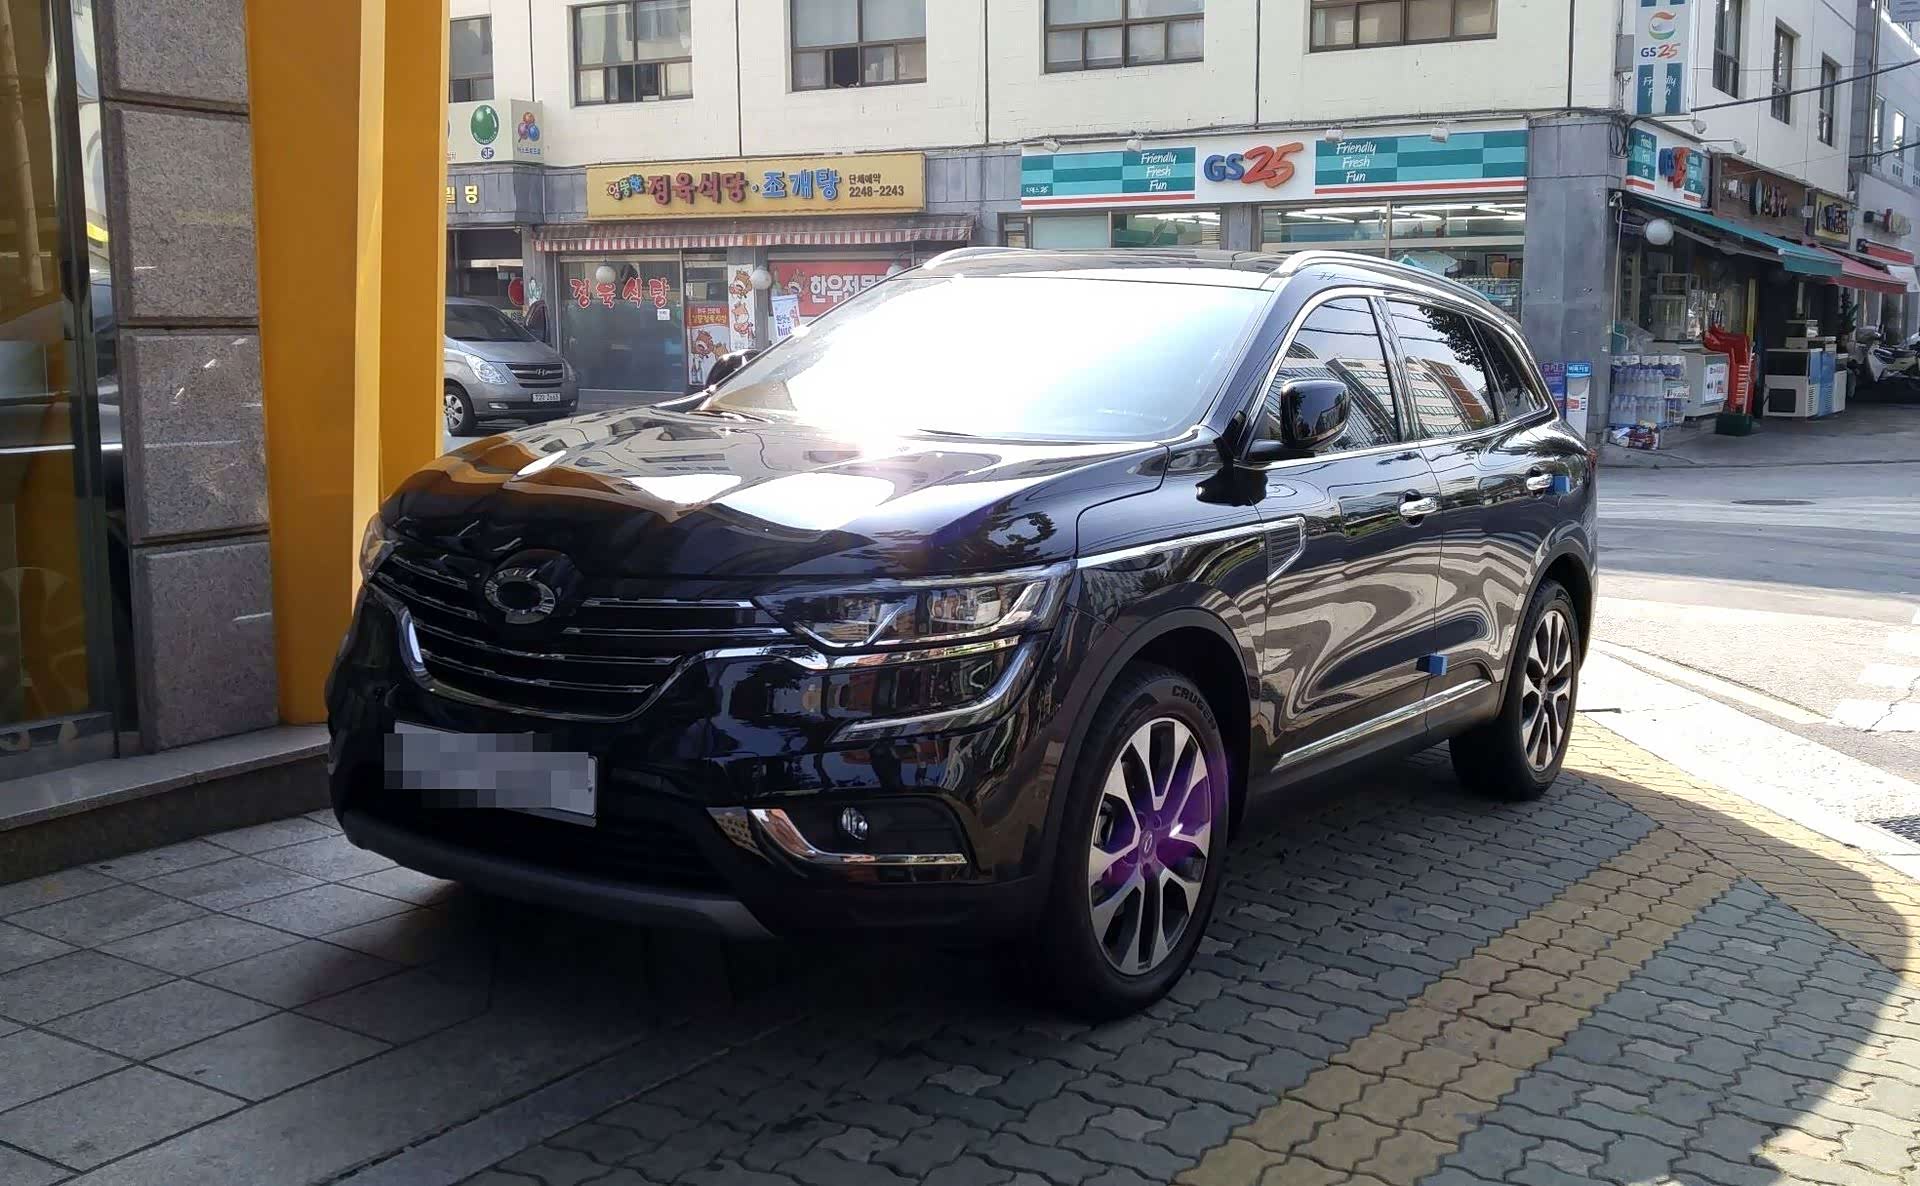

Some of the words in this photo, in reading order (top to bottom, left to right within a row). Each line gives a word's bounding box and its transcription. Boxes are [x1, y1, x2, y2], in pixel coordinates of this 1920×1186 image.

[1640, 42, 1681, 58] GS25
[481, 147, 495, 159] 3F
[1336, 142, 1377, 156] Friendly
[1141, 152, 1177, 165] Friendly
[1203, 142, 1304, 188] GS25
[1342, 155, 1371, 169] Fresh
[1146, 165, 1172, 178] Fresh
[1346, 170, 1366, 183] Fun
[762, 168, 841, 200] 조개탕
[1149, 180, 1167, 191] Fun
[849, 185, 904, 198] 2248-2243
